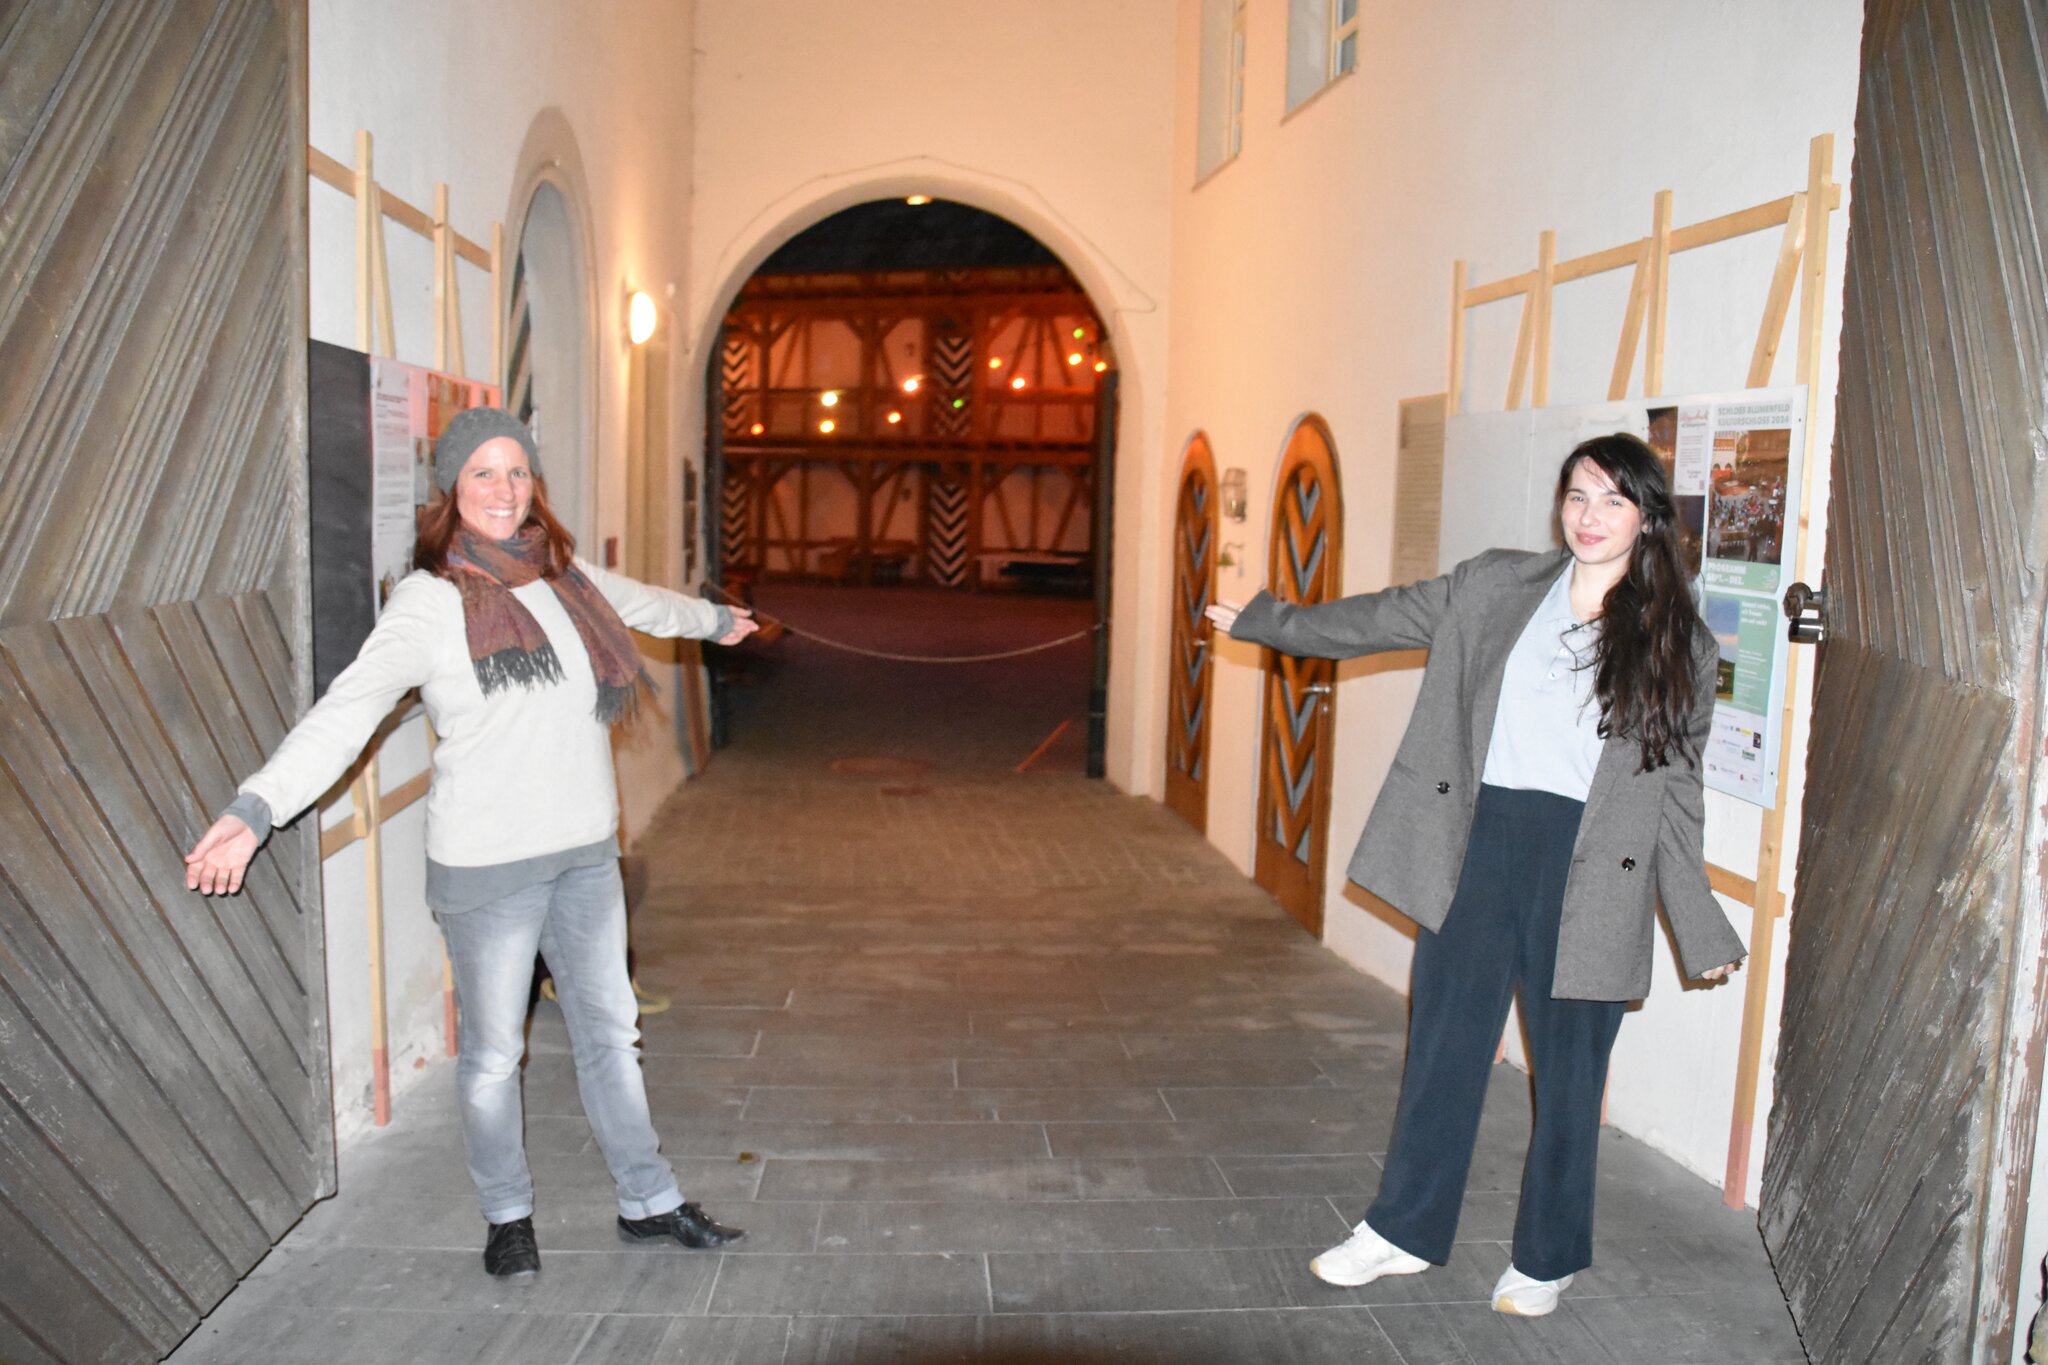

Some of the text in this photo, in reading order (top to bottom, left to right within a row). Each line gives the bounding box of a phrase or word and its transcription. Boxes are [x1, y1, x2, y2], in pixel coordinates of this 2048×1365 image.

[1718, 406, 1746, 416] SCHLOSS
[1747, 403, 1790, 414] BLUMENFELD
[1718, 416, 1770, 426] KULTURSCHLOSS
[1708, 562, 1746, 575] PROGRAMM
